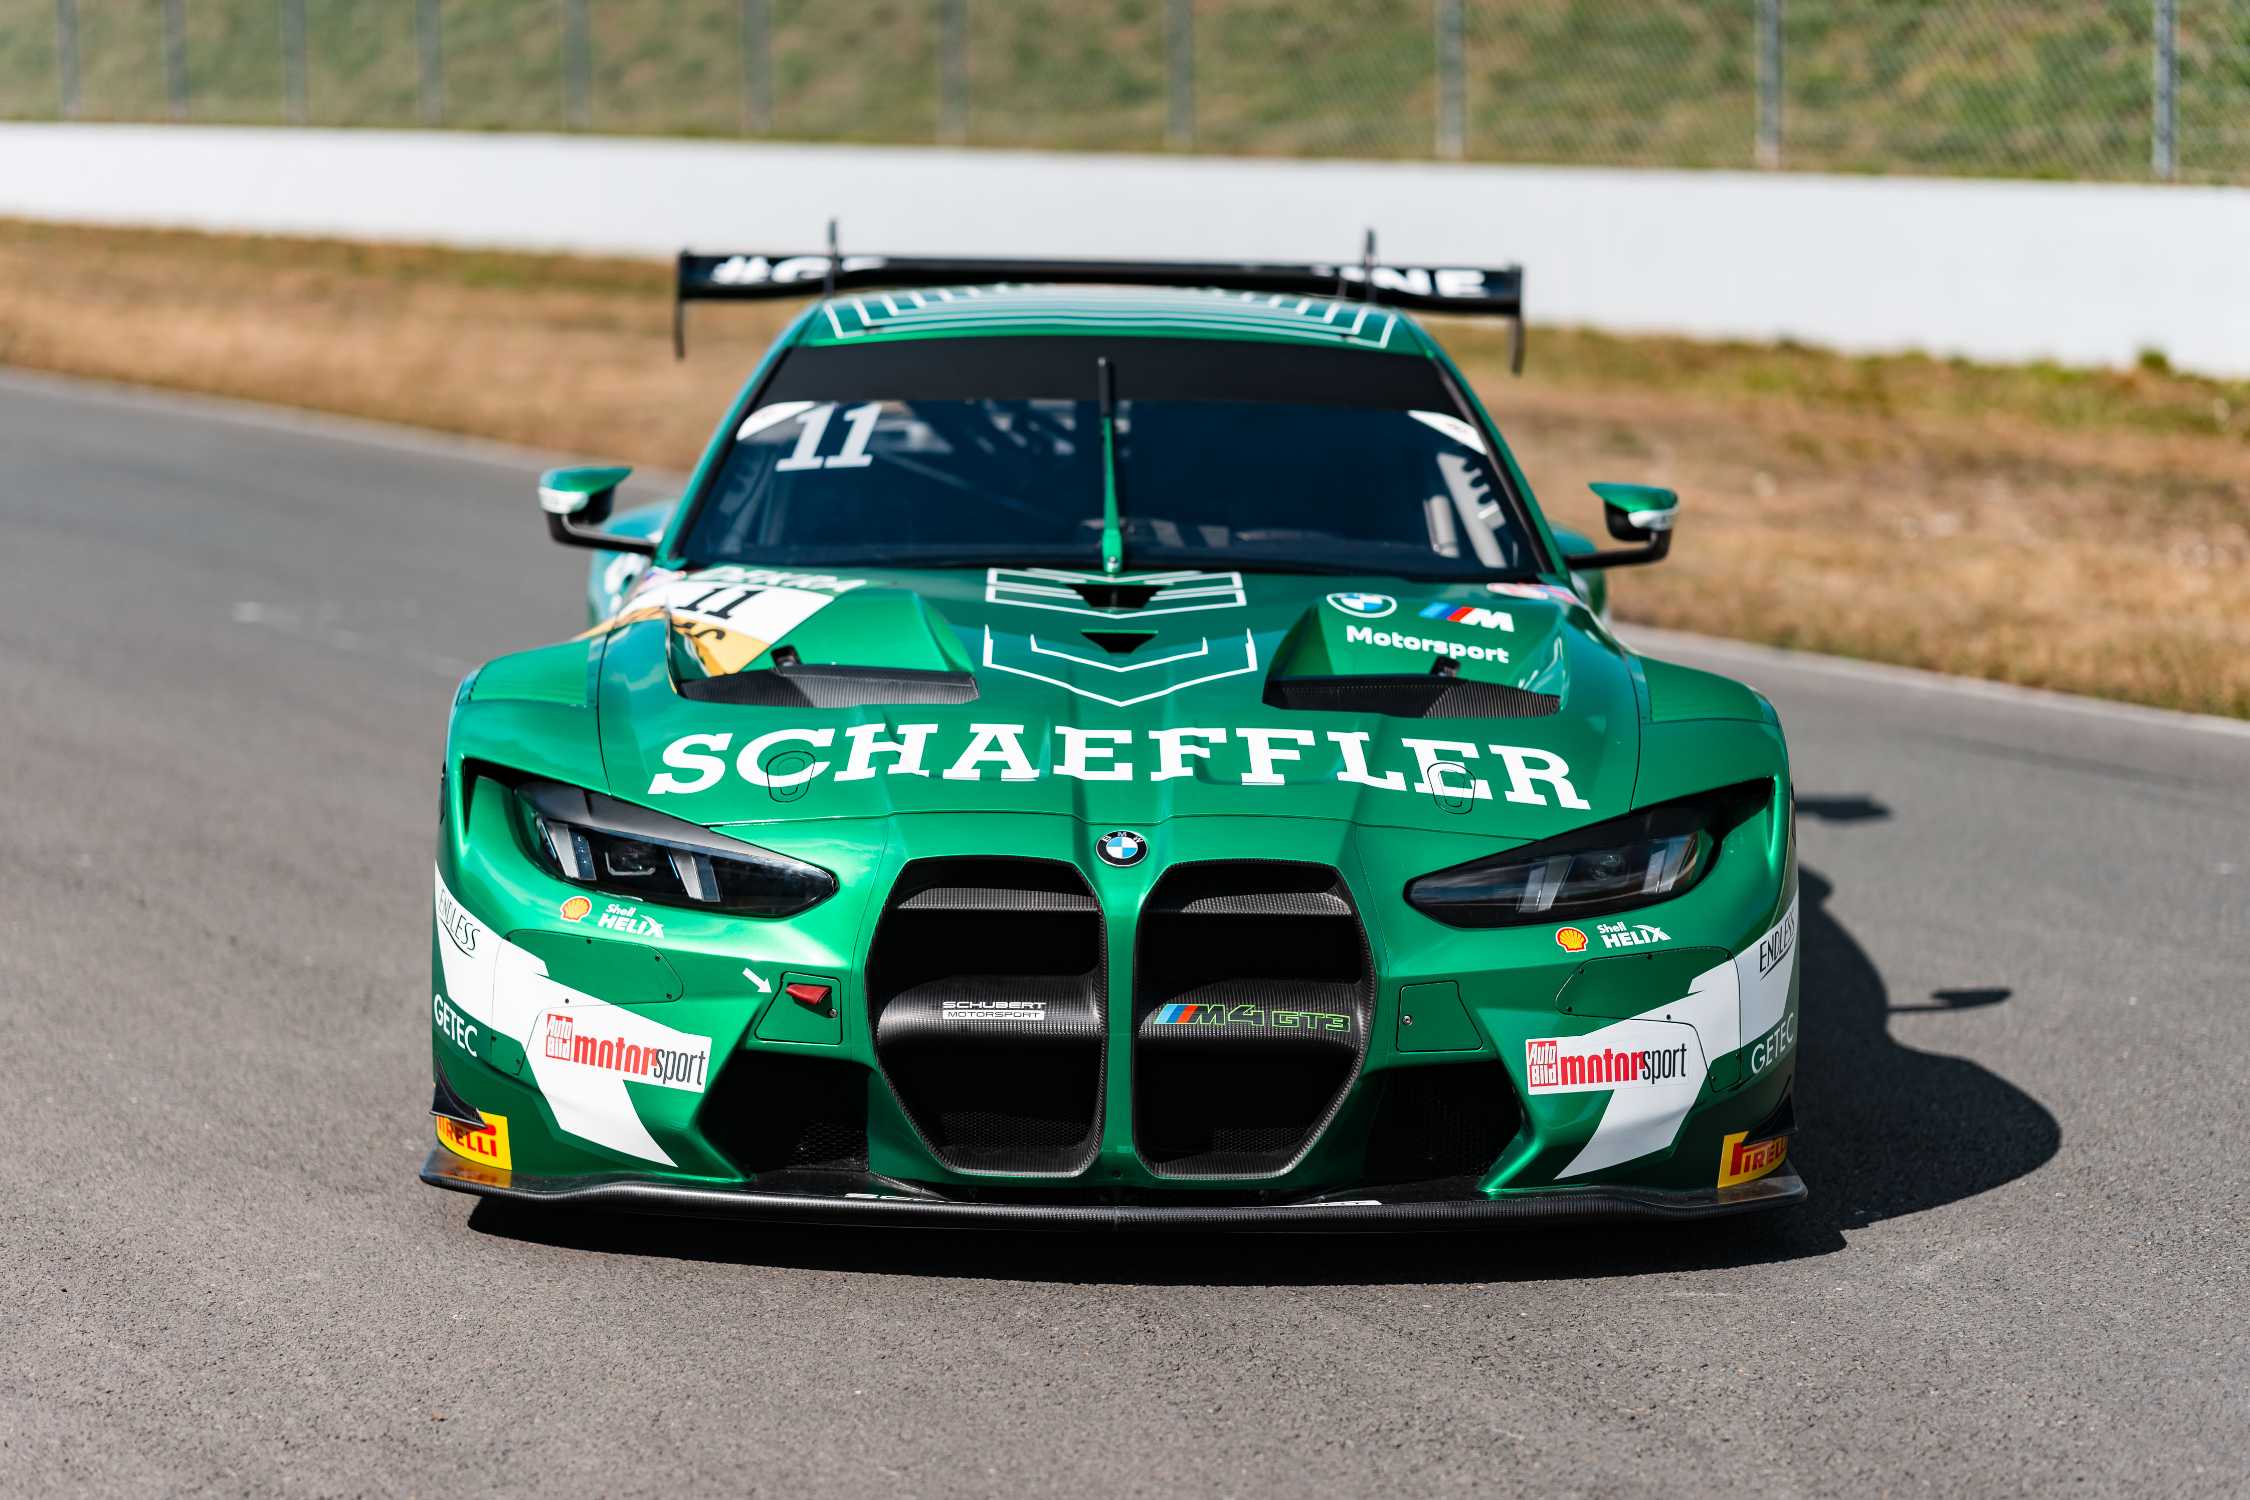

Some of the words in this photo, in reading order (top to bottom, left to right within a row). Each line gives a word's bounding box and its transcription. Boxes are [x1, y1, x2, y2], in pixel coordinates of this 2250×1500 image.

[775, 401, 882, 472] 11
[675, 588, 765, 619] 11
[1458, 607, 1514, 632] M
[1346, 625, 1509, 663] Motorsport
[647, 723, 1591, 810] SCHAEFFLER
[439, 888, 481, 951] ENDLESS
[598, 912, 664, 939] HELIX
[606, 903, 637, 917] Shell
[1597, 921, 1627, 934] Shell
[1601, 925, 1672, 948] HELIX
[1759, 911, 1795, 973] ENDLESS
[943, 1001, 1046, 1009] SCHUBERT
[434, 994, 478, 1057] GETEC
[1272, 1010, 1350, 1032] GT3
[1751, 1012, 1794, 1074] GETEC
